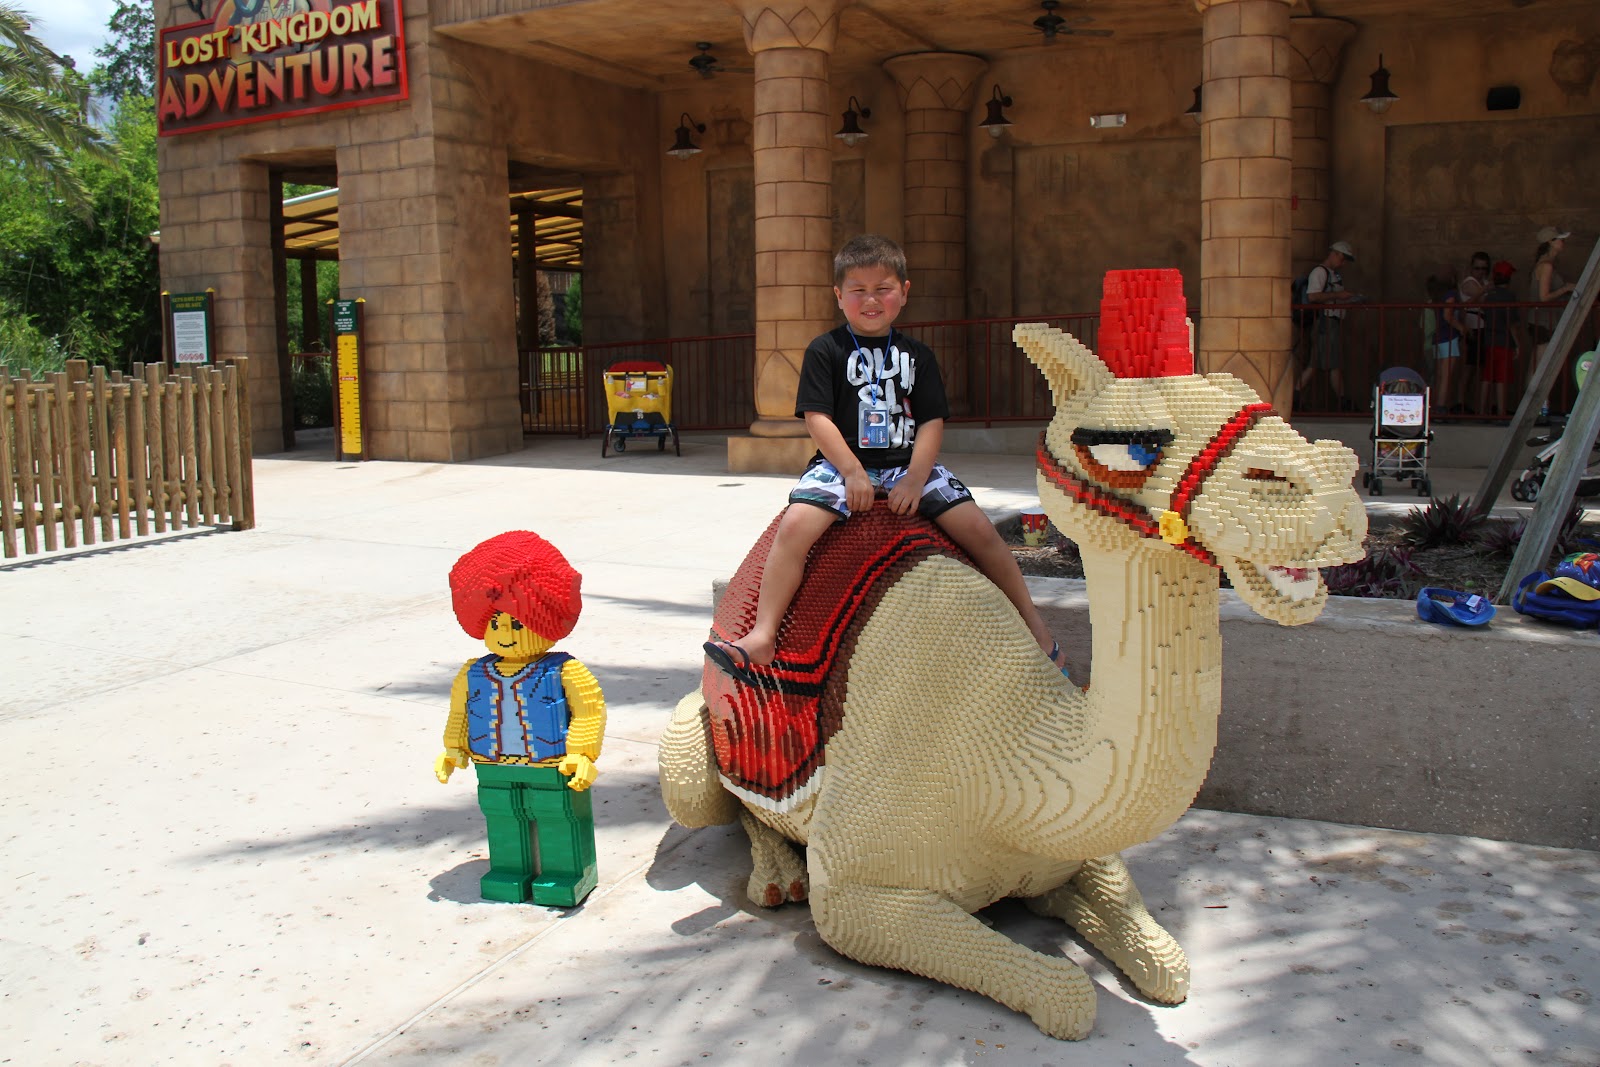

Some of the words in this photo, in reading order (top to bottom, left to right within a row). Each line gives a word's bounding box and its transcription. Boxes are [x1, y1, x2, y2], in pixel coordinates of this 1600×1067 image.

[166, 28, 231, 68] LOST
[241, 1, 380, 53] KINGDOM
[158, 35, 396, 121] ADVENTURE
